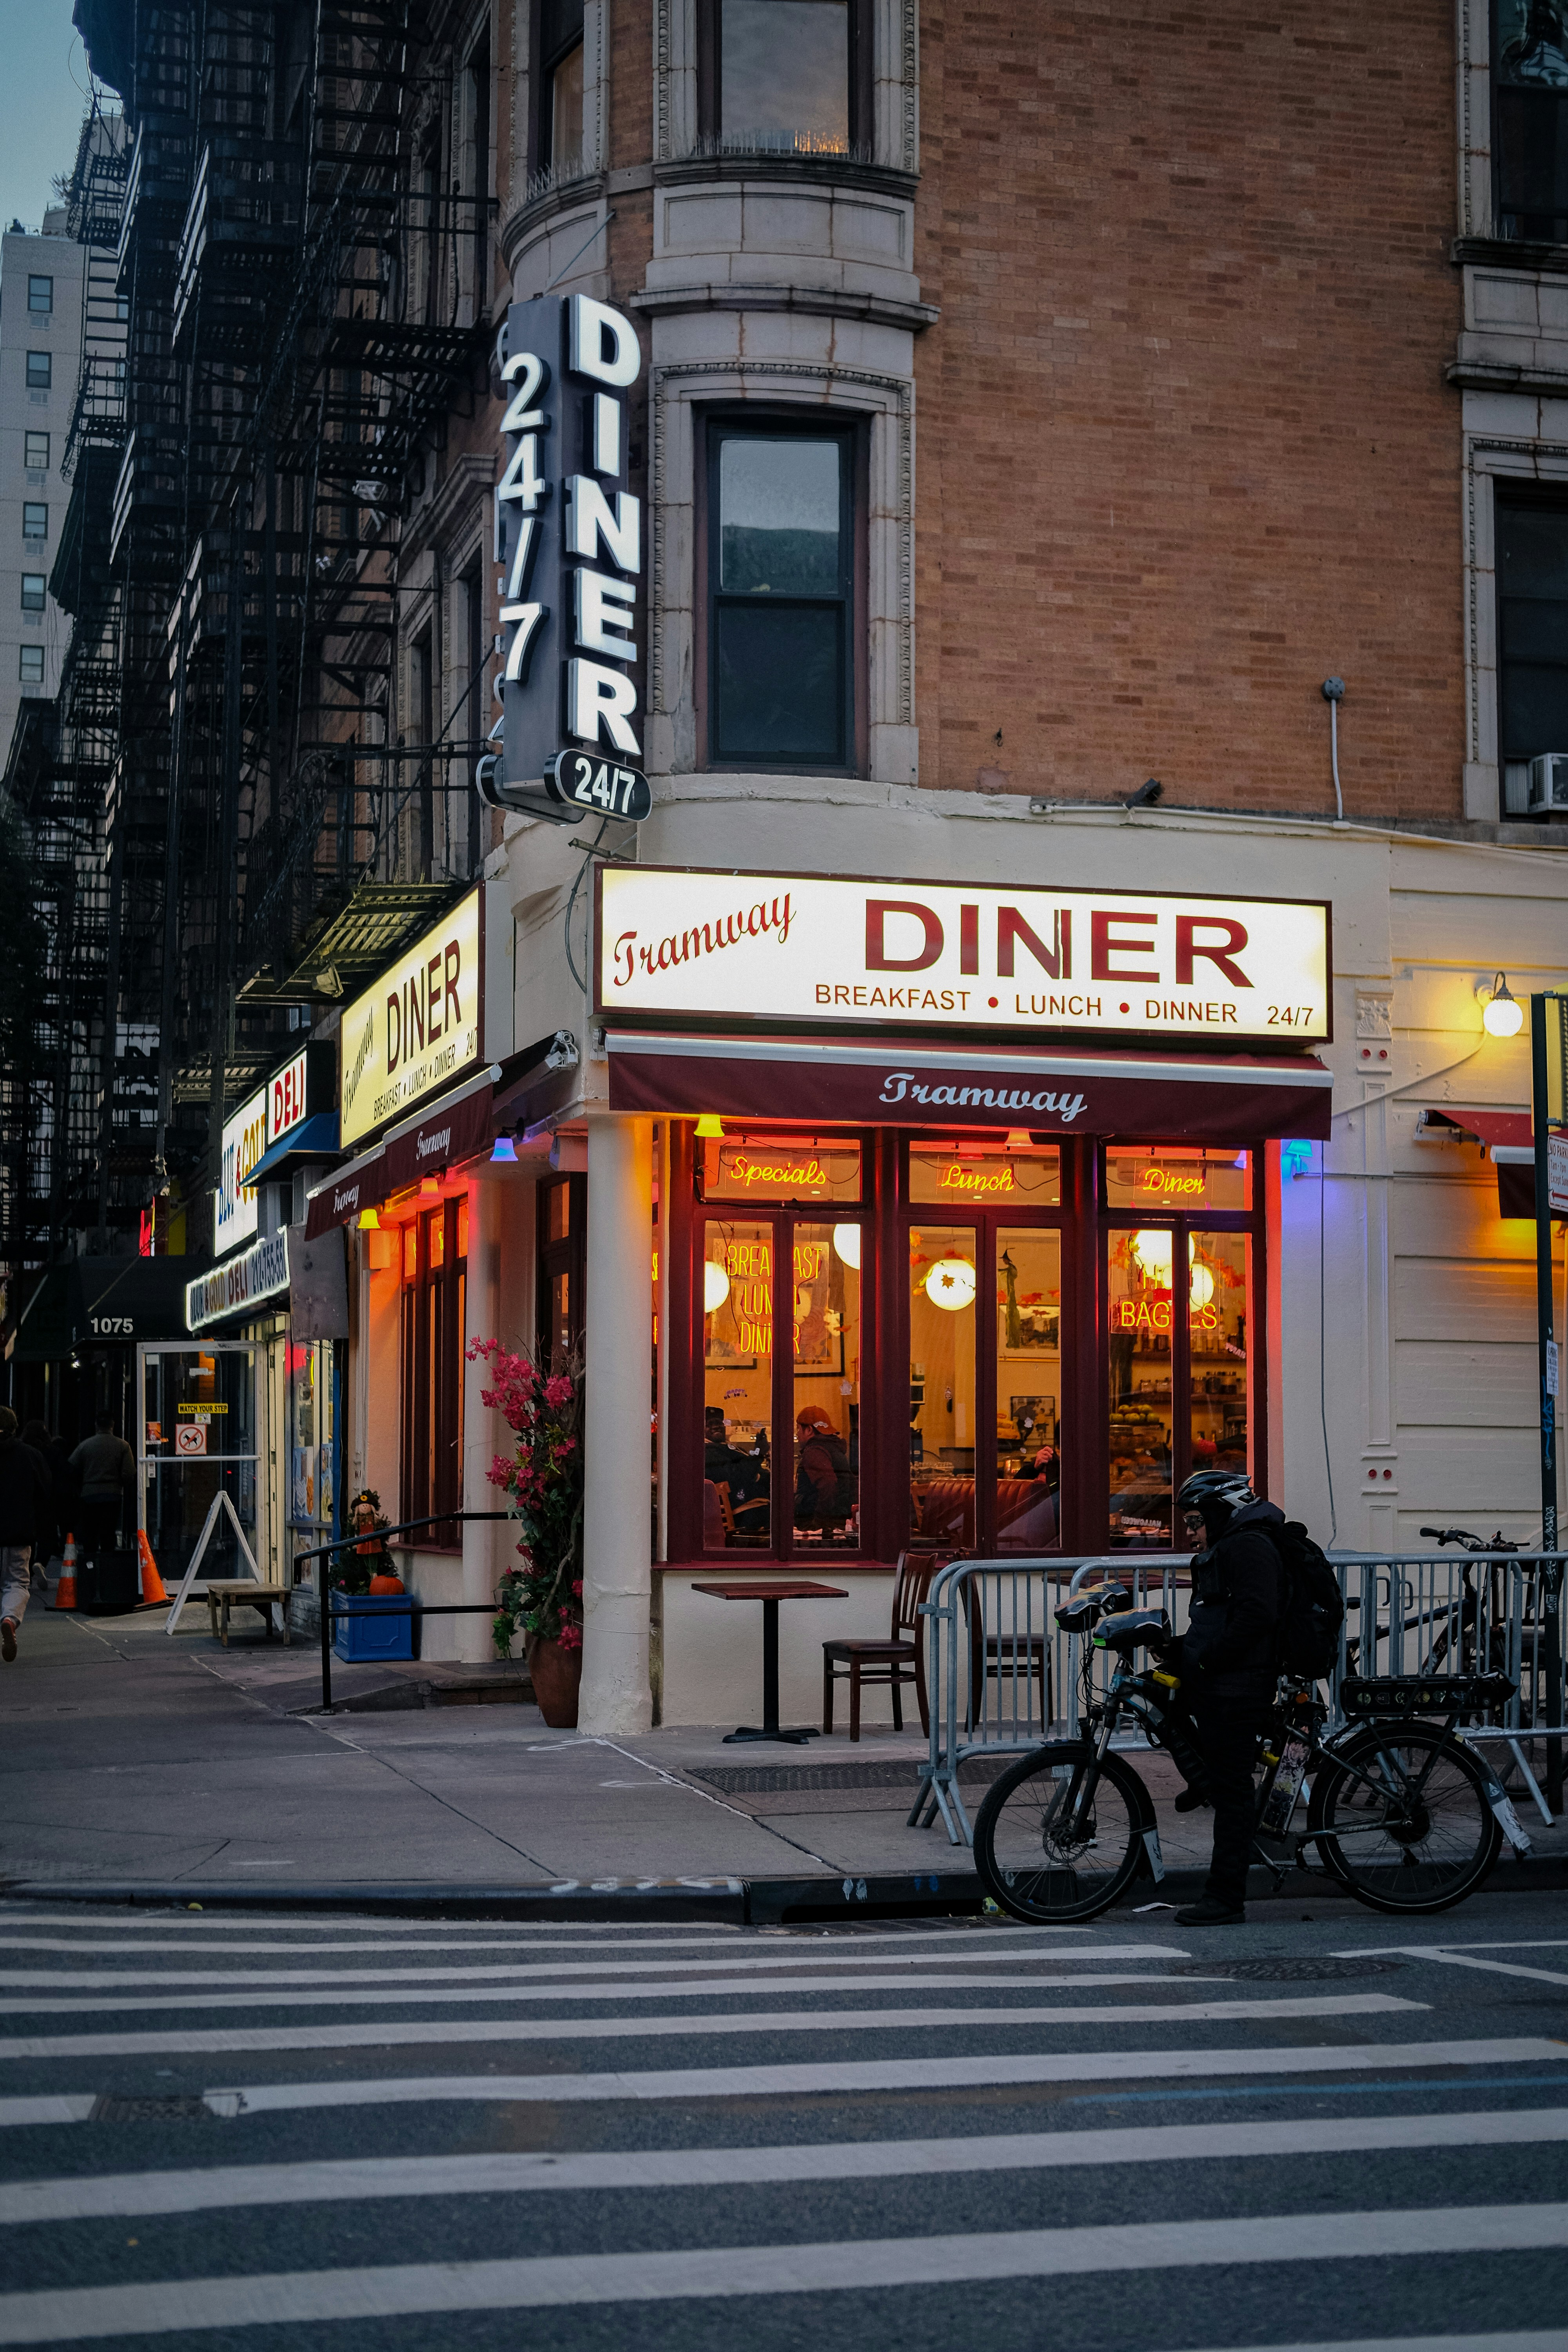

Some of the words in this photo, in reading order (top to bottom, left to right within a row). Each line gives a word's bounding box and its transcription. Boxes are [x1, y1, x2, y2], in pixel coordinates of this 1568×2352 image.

[499, 353, 544, 681] 24/7
[574, 294, 641, 755] DINER
[575, 757, 635, 814] 24/7
[614, 893, 797, 986] Tramway
[865, 898, 1256, 988] DINER
[387, 939, 461, 1076] DINER
[815, 984, 971, 1012] BREAKFAST
[1014, 993, 1102, 1017] LUNCH
[1145, 1000, 1238, 1023] DINNER
[1267, 1005, 1314, 1027] 24/7
[344, 1005, 374, 1124] Tramway
[374, 1082, 401, 1121] BREAKFAST
[408, 1064, 426, 1096] LUNCH
[435, 1044, 455, 1079] DINNER
[466, 1026, 478, 1058] 24/7
[274, 1059, 303, 1136] DELI
[878, 1073, 1088, 1122] Tramway
[242, 1113, 265, 1206] GOL
[416, 1127, 450, 1160] Tramway
[1550, 1142, 1556, 1156] NO
[730, 1156, 827, 1186] Specials
[941, 1165, 1015, 1192] Lunch
[1144, 1167, 1205, 1195] Diner
[209, 1272, 225, 1313] GOLD
[228, 1258, 248, 1306] DELI
[251, 1238, 287, 1294] 212-755-55
[728, 1245, 823, 1279] BREAAST
[744, 1284, 797, 1316] LUN
[1122, 1301, 1217, 1329] BAGS
[91, 1318, 133, 1333] 1075
[740, 1321, 800, 1354] DINR
